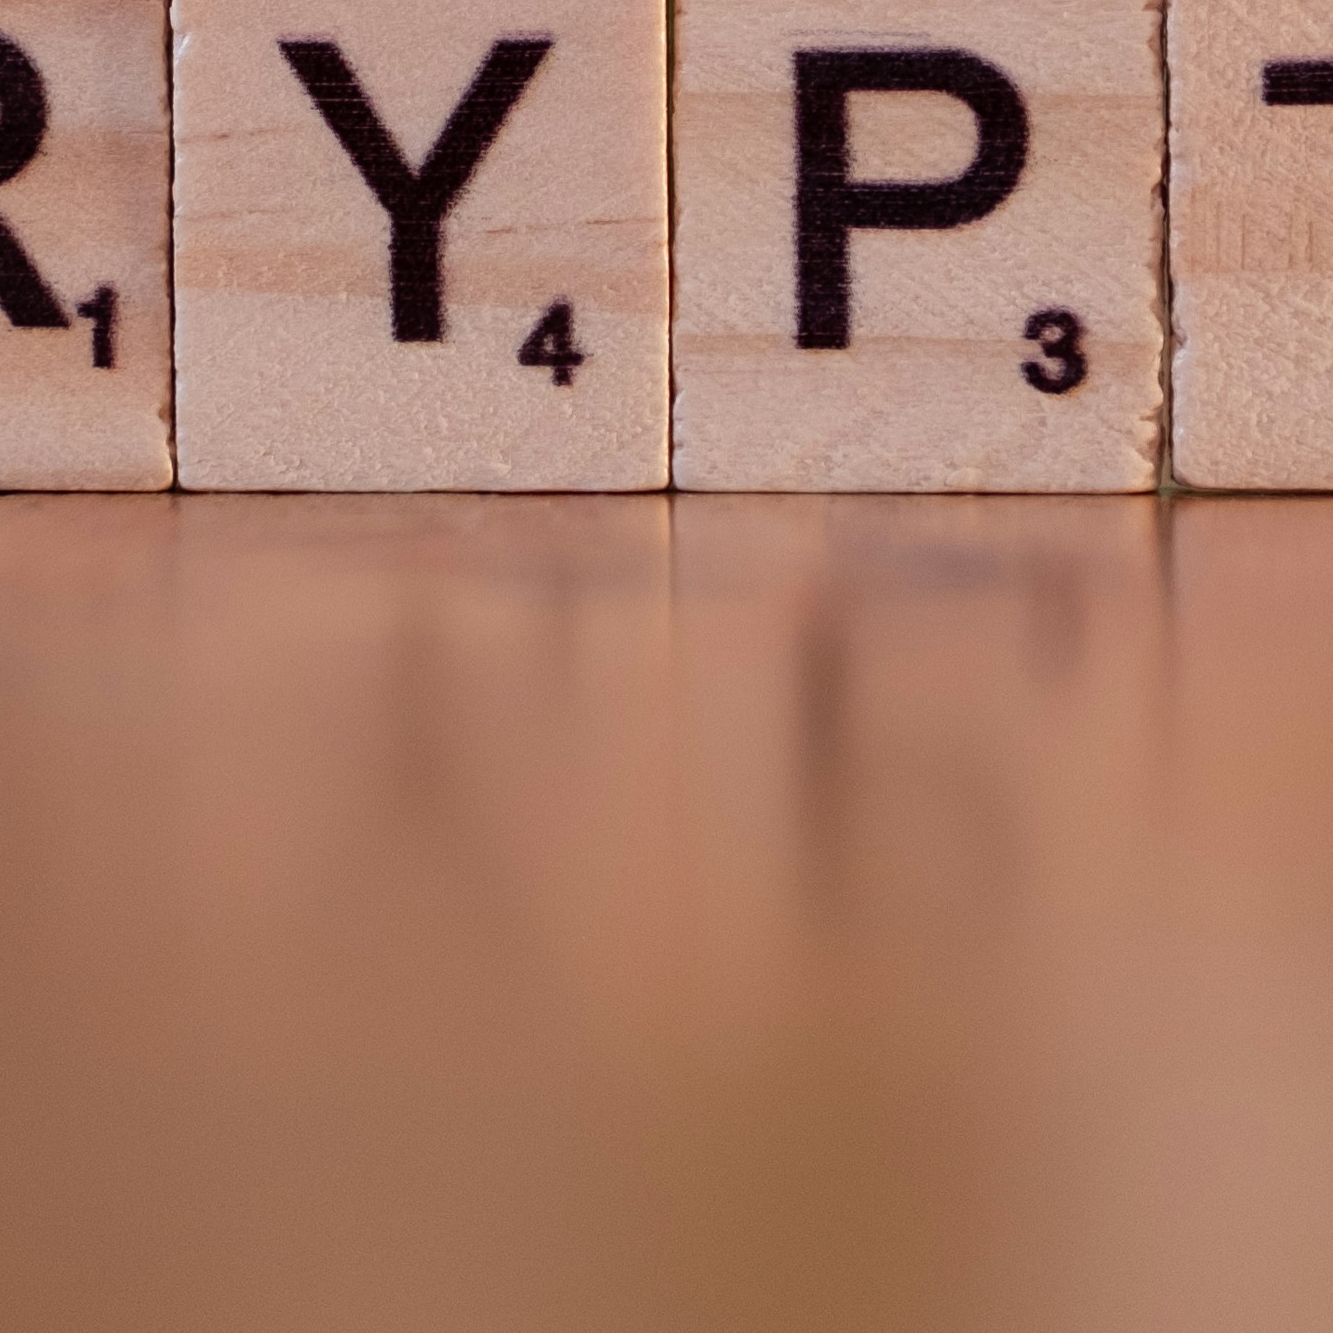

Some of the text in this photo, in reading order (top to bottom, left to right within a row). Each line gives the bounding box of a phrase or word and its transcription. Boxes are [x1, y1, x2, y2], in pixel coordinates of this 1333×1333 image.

[72, 282, 122, 373] 1
[515, 298, 588, 389] 4
[1018, 305, 1091, 398] 3
